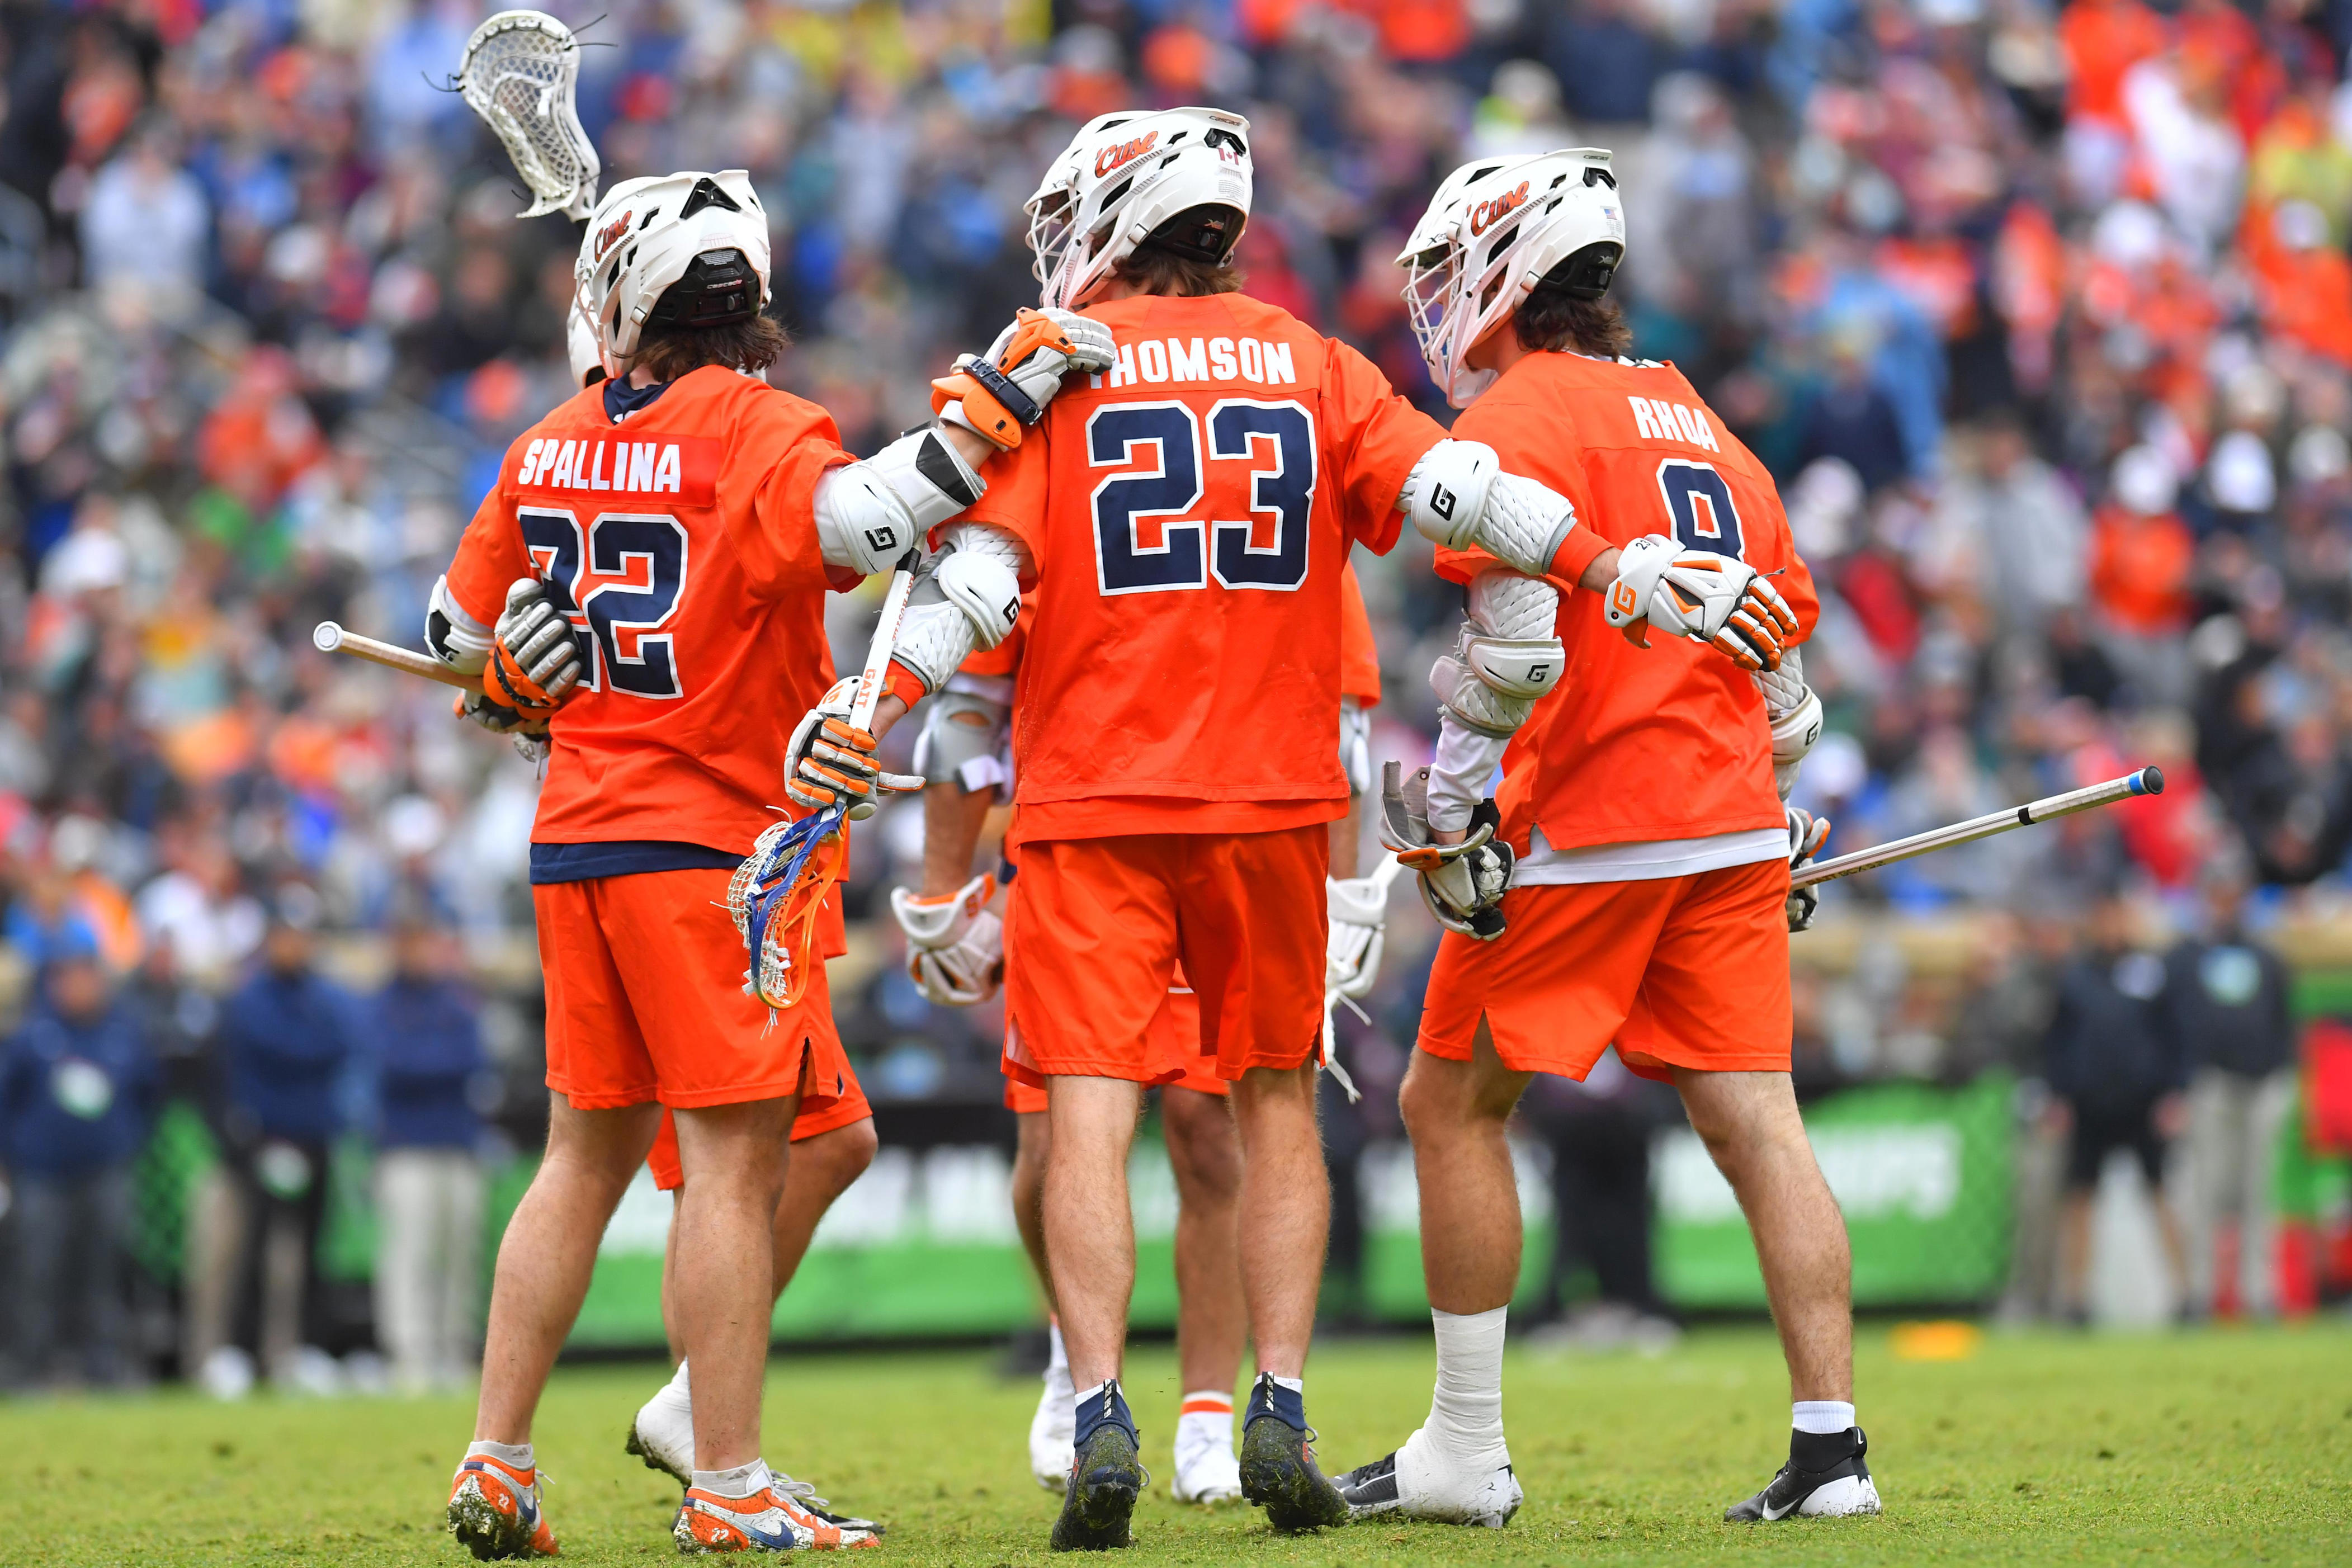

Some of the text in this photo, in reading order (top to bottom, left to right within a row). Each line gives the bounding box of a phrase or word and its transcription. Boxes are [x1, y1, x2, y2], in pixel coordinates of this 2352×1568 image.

[1627, 395, 1720, 454] RHOA
[518, 438, 681, 493] SPALLINA
[1085, 398, 1317, 597] 23
[517, 506, 688, 700] 22
[857, 669, 876, 708] GAIT
